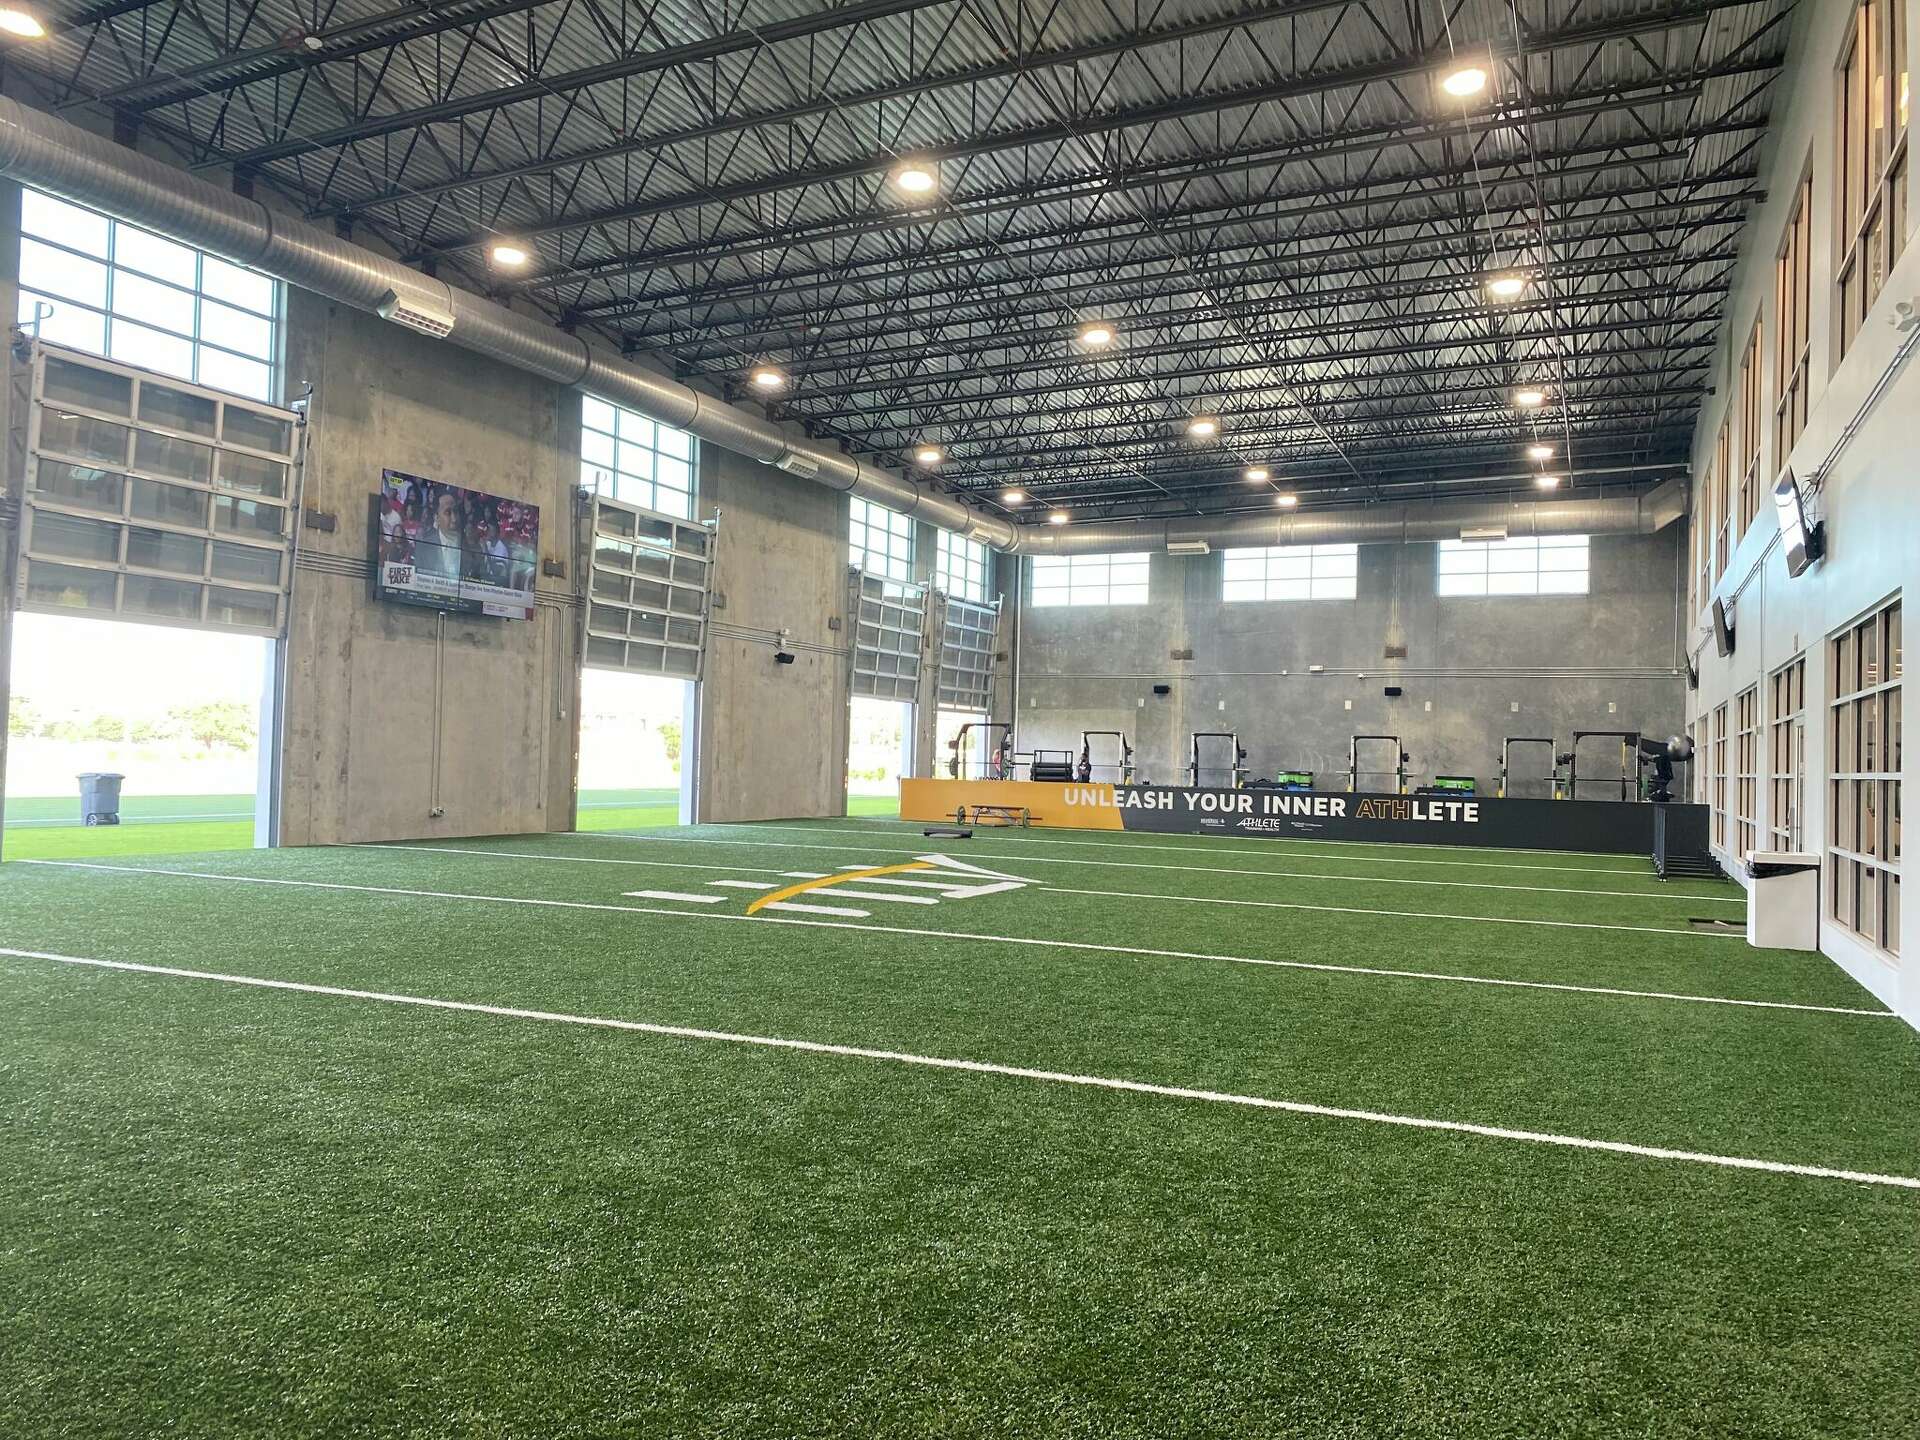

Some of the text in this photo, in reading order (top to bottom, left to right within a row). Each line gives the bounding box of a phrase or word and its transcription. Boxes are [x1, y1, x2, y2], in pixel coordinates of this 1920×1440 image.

[389, 567, 412, 576] FIRST
[389, 575, 410, 584] TAKE
[1064, 788, 1479, 823] UNLEASH YOUR INNER ATHLETE
[1236, 817, 1281, 828] ATHLETE
